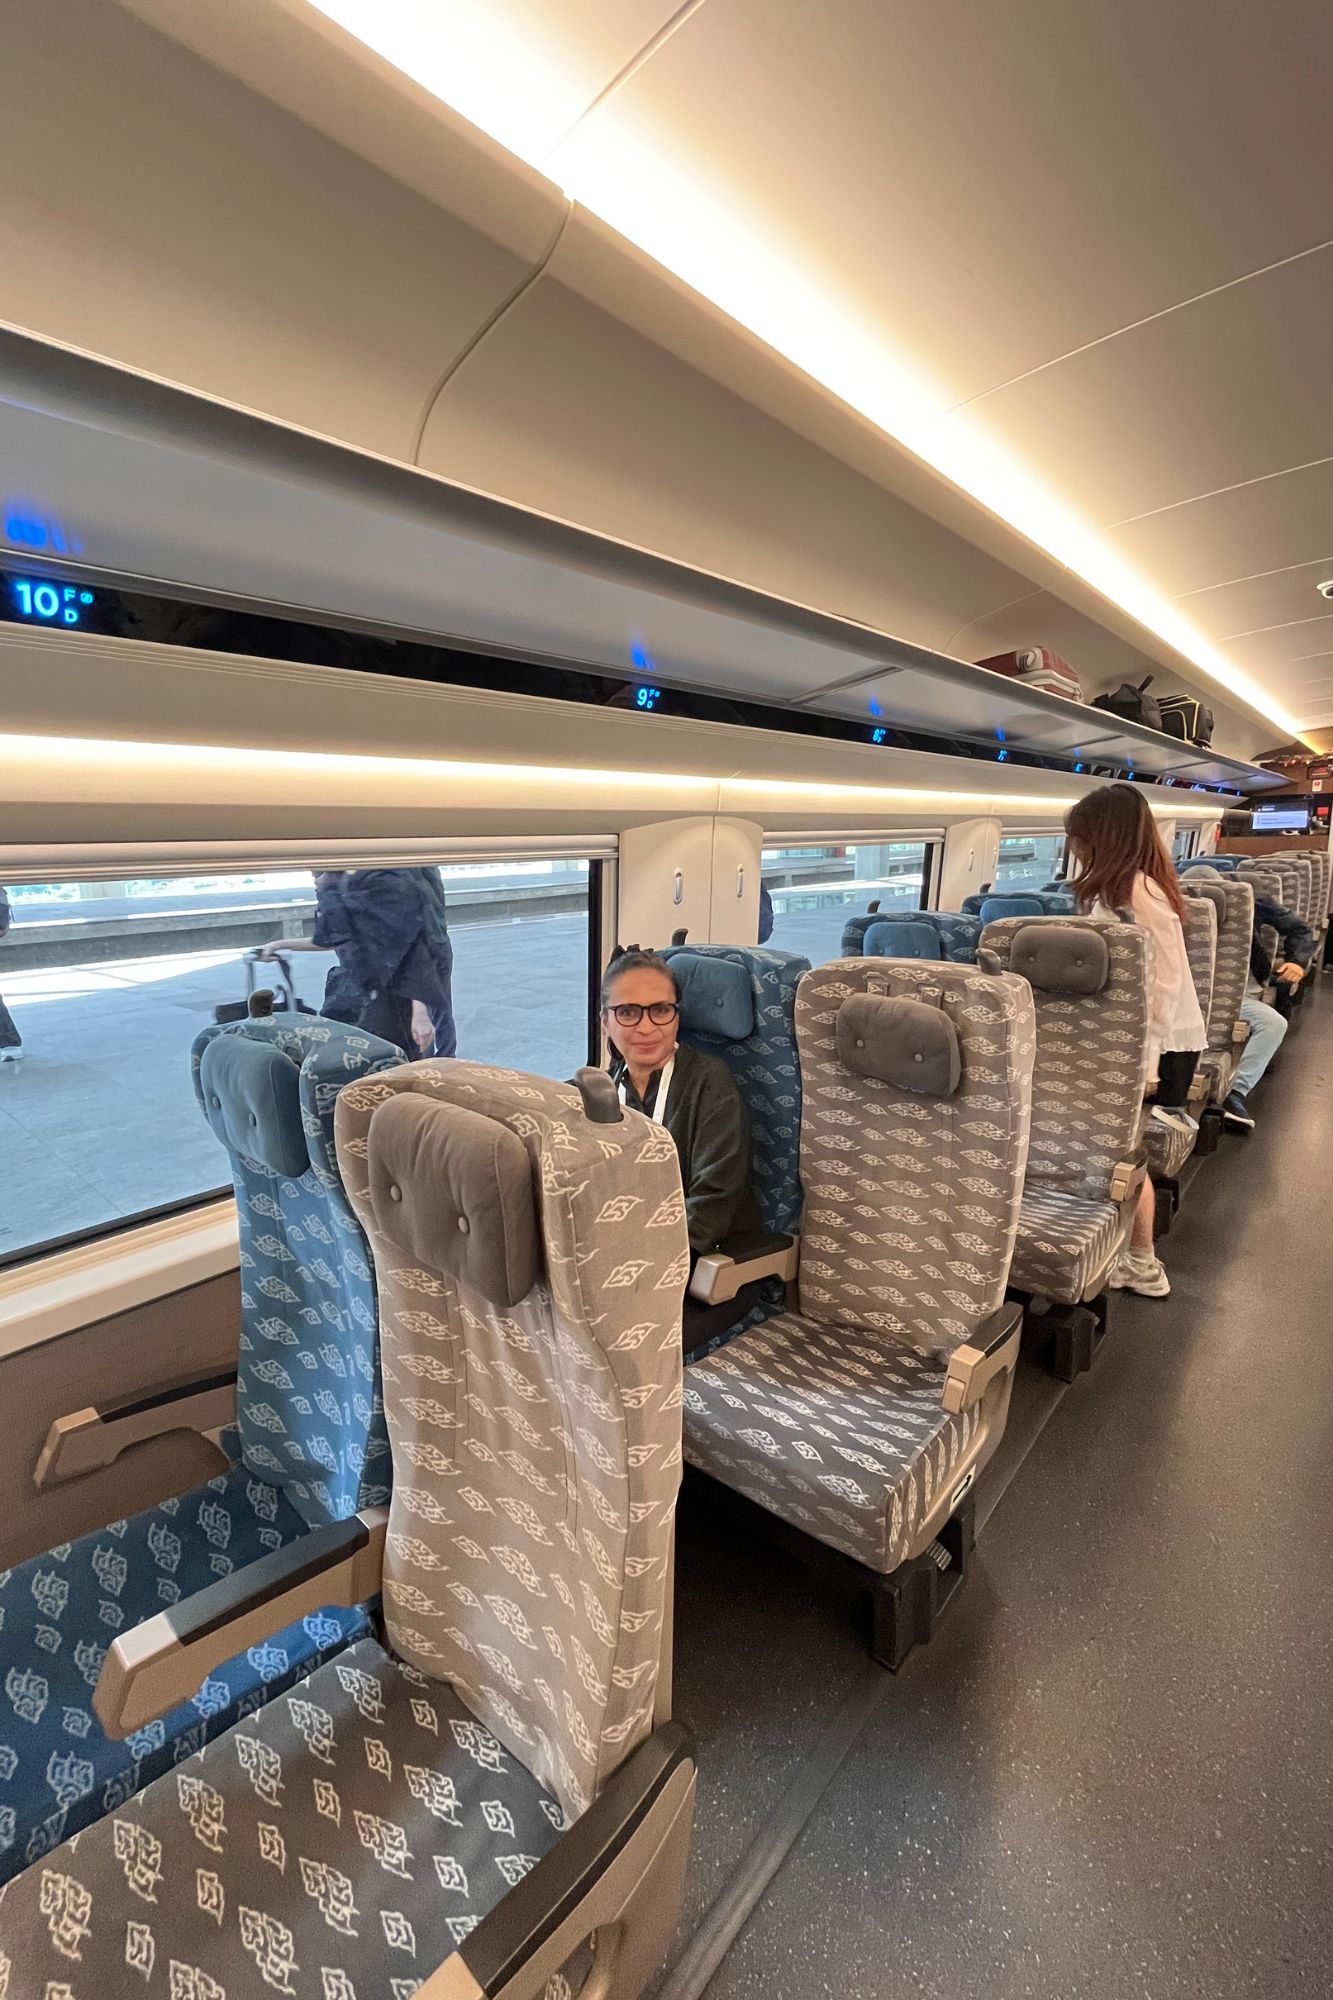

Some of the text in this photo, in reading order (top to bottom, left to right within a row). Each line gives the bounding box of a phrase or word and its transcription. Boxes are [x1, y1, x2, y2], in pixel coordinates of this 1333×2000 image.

[15, 583, 76, 617] 10 F
[64, 608, 78, 623] D
[637, 688, 648, 706] 9
